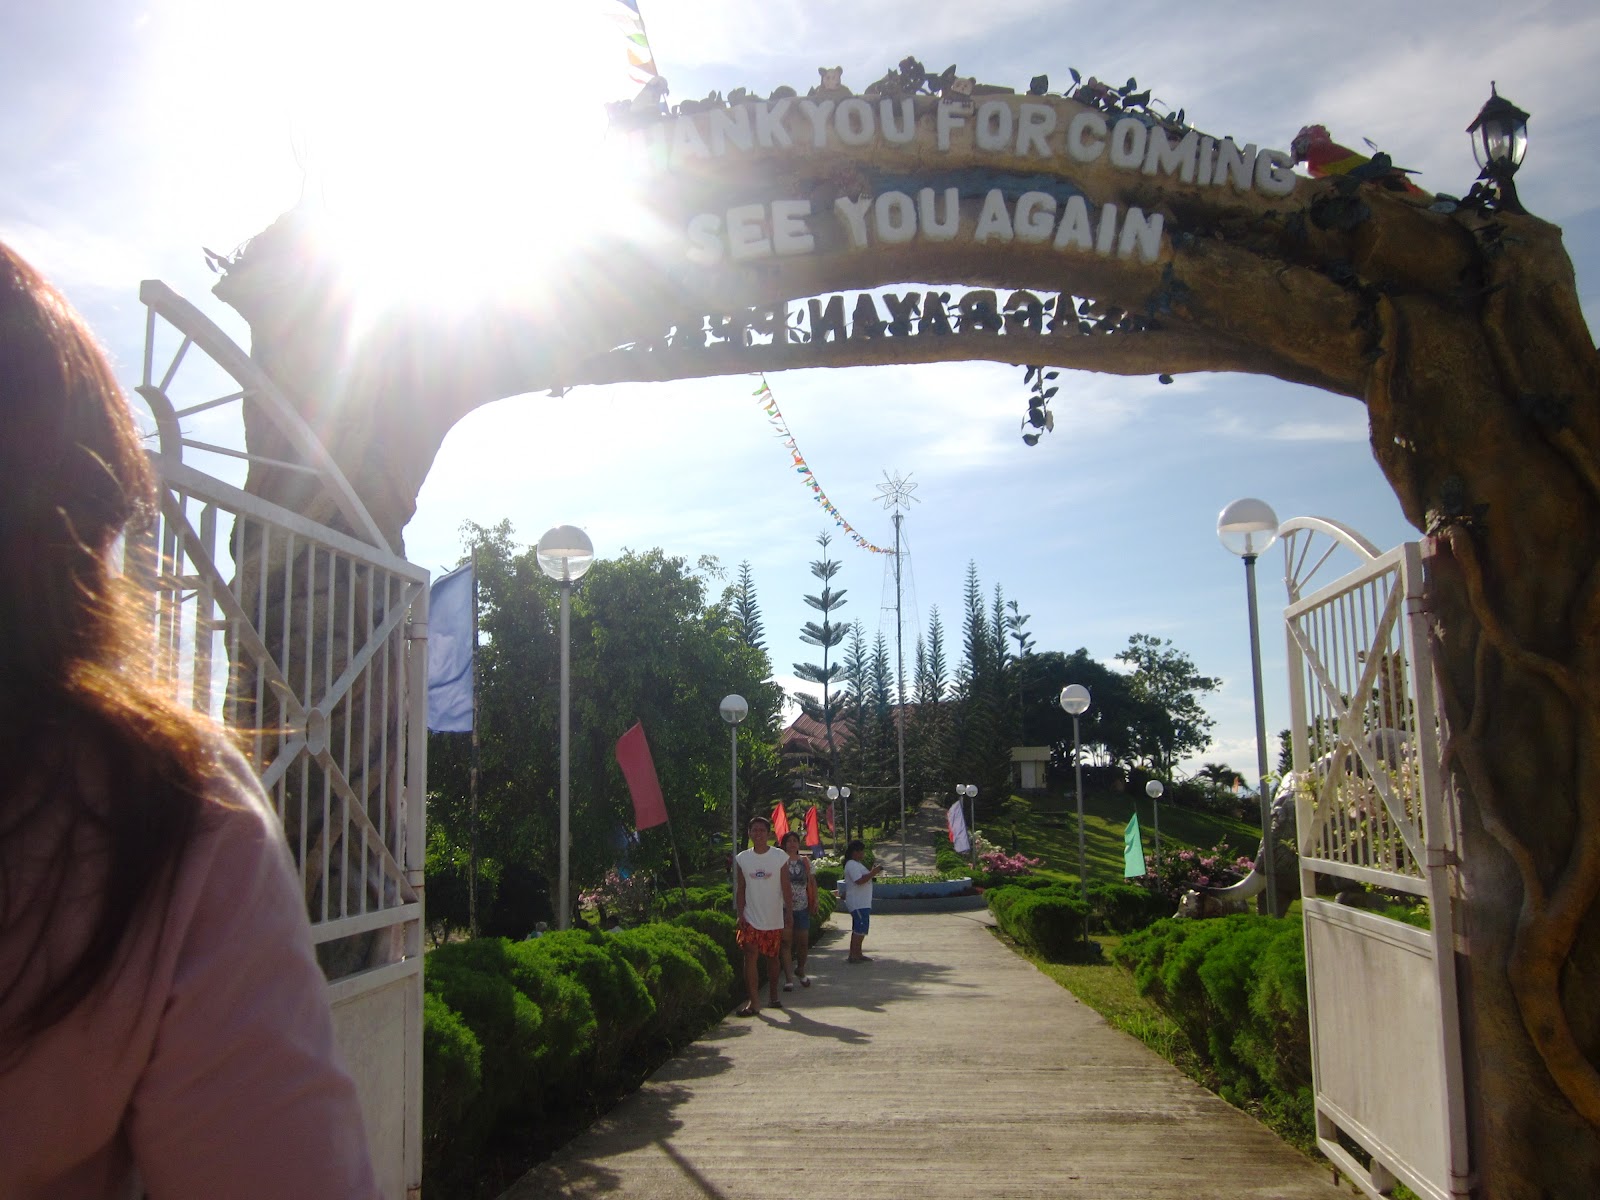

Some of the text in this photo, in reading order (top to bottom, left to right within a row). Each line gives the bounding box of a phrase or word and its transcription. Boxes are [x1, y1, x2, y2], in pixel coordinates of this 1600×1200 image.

[801, 98, 916, 148] YOU
[937, 99, 1057, 159] FOR
[1066, 112, 1297, 197] COMING
[686, 187, 1165, 264] SEE YOU AGAIN
